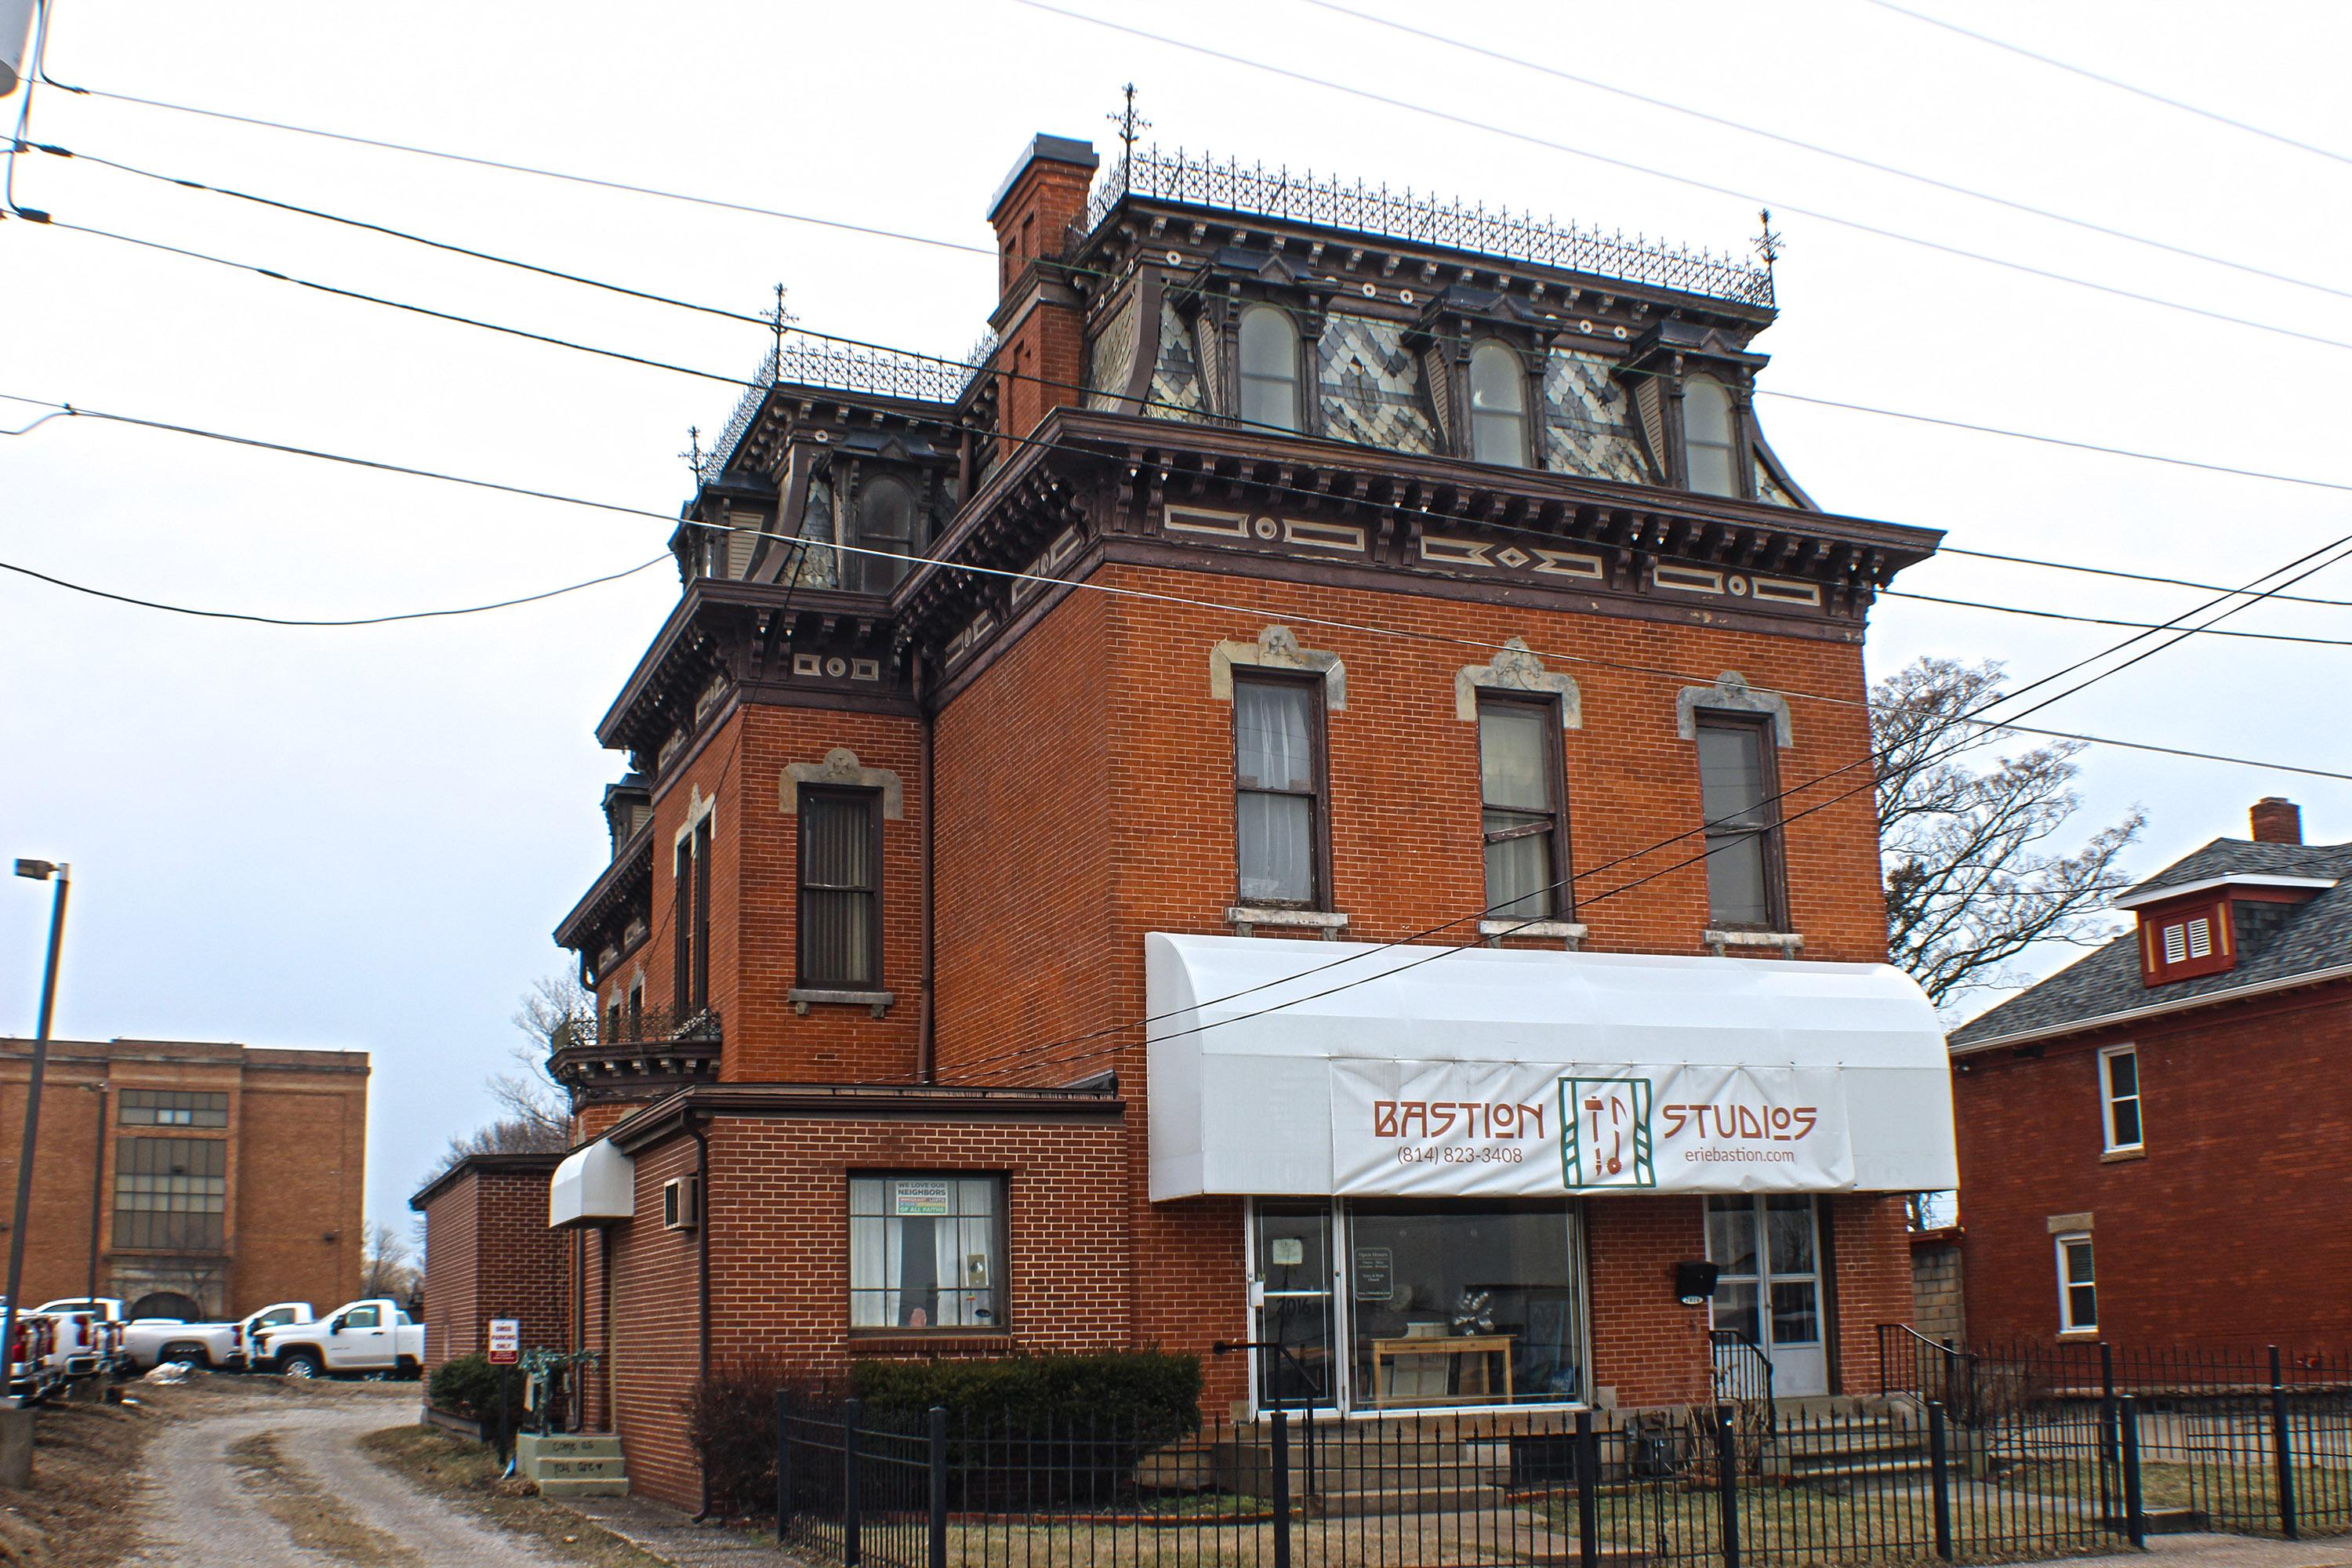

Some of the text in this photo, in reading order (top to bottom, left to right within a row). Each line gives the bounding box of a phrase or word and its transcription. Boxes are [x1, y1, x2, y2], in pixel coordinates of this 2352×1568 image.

[1374, 1101, 1817, 1141] BASTION STUDIOS
[1397, 1145, 1523, 1165] (814) 823-3408
[1685, 1146, 1795, 1162] eriebastion.com
